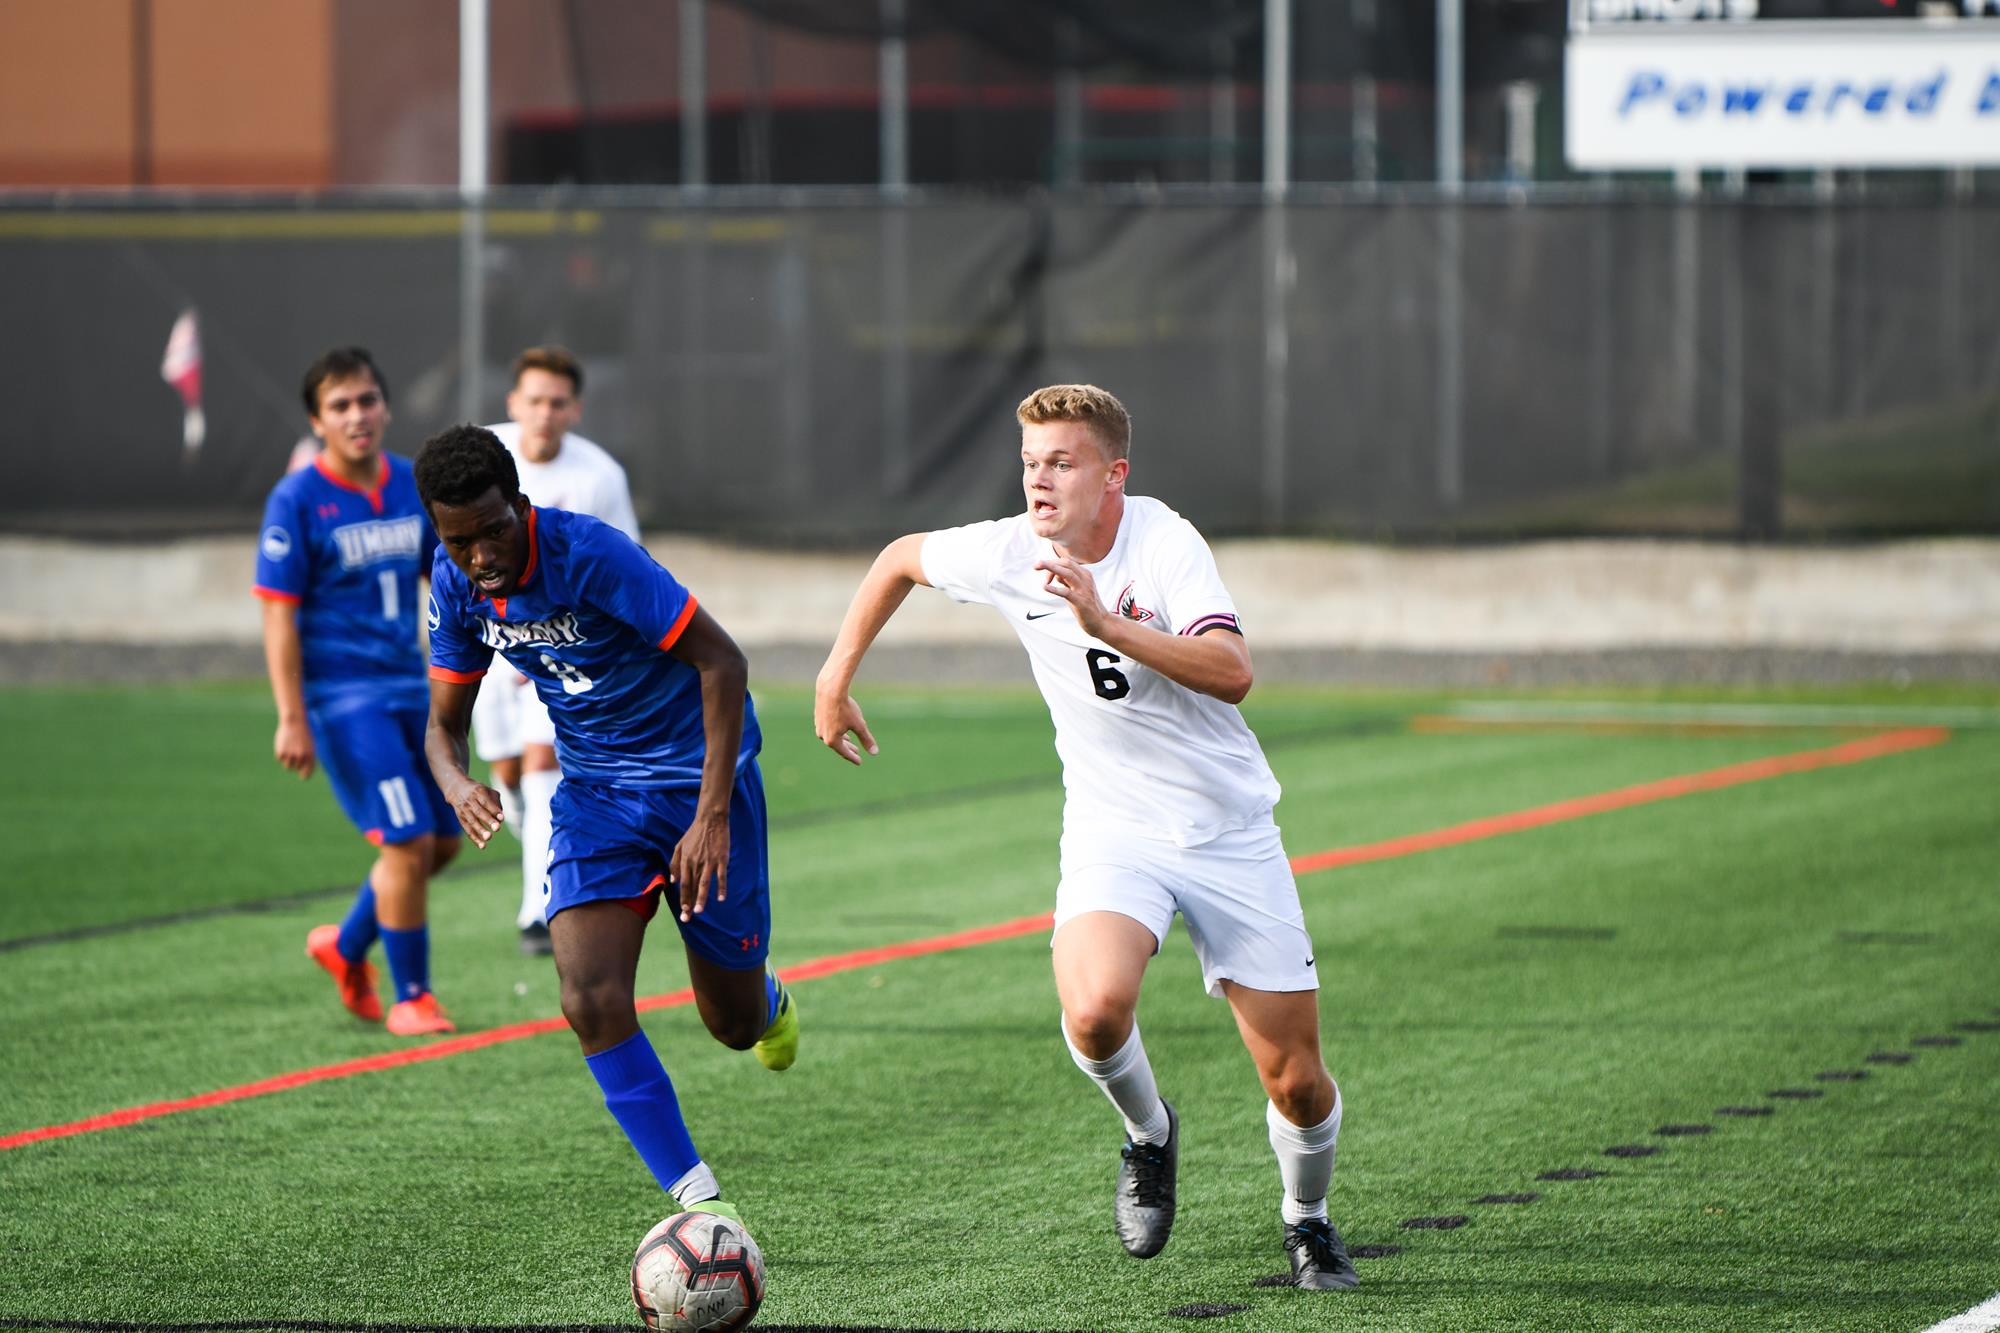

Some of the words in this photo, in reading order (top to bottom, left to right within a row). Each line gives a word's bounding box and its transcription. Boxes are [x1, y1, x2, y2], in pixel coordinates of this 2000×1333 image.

[1618, 68, 1948, 118] Powered
[1086, 648, 1130, 701] 6
[378, 777, 416, 828] 11
